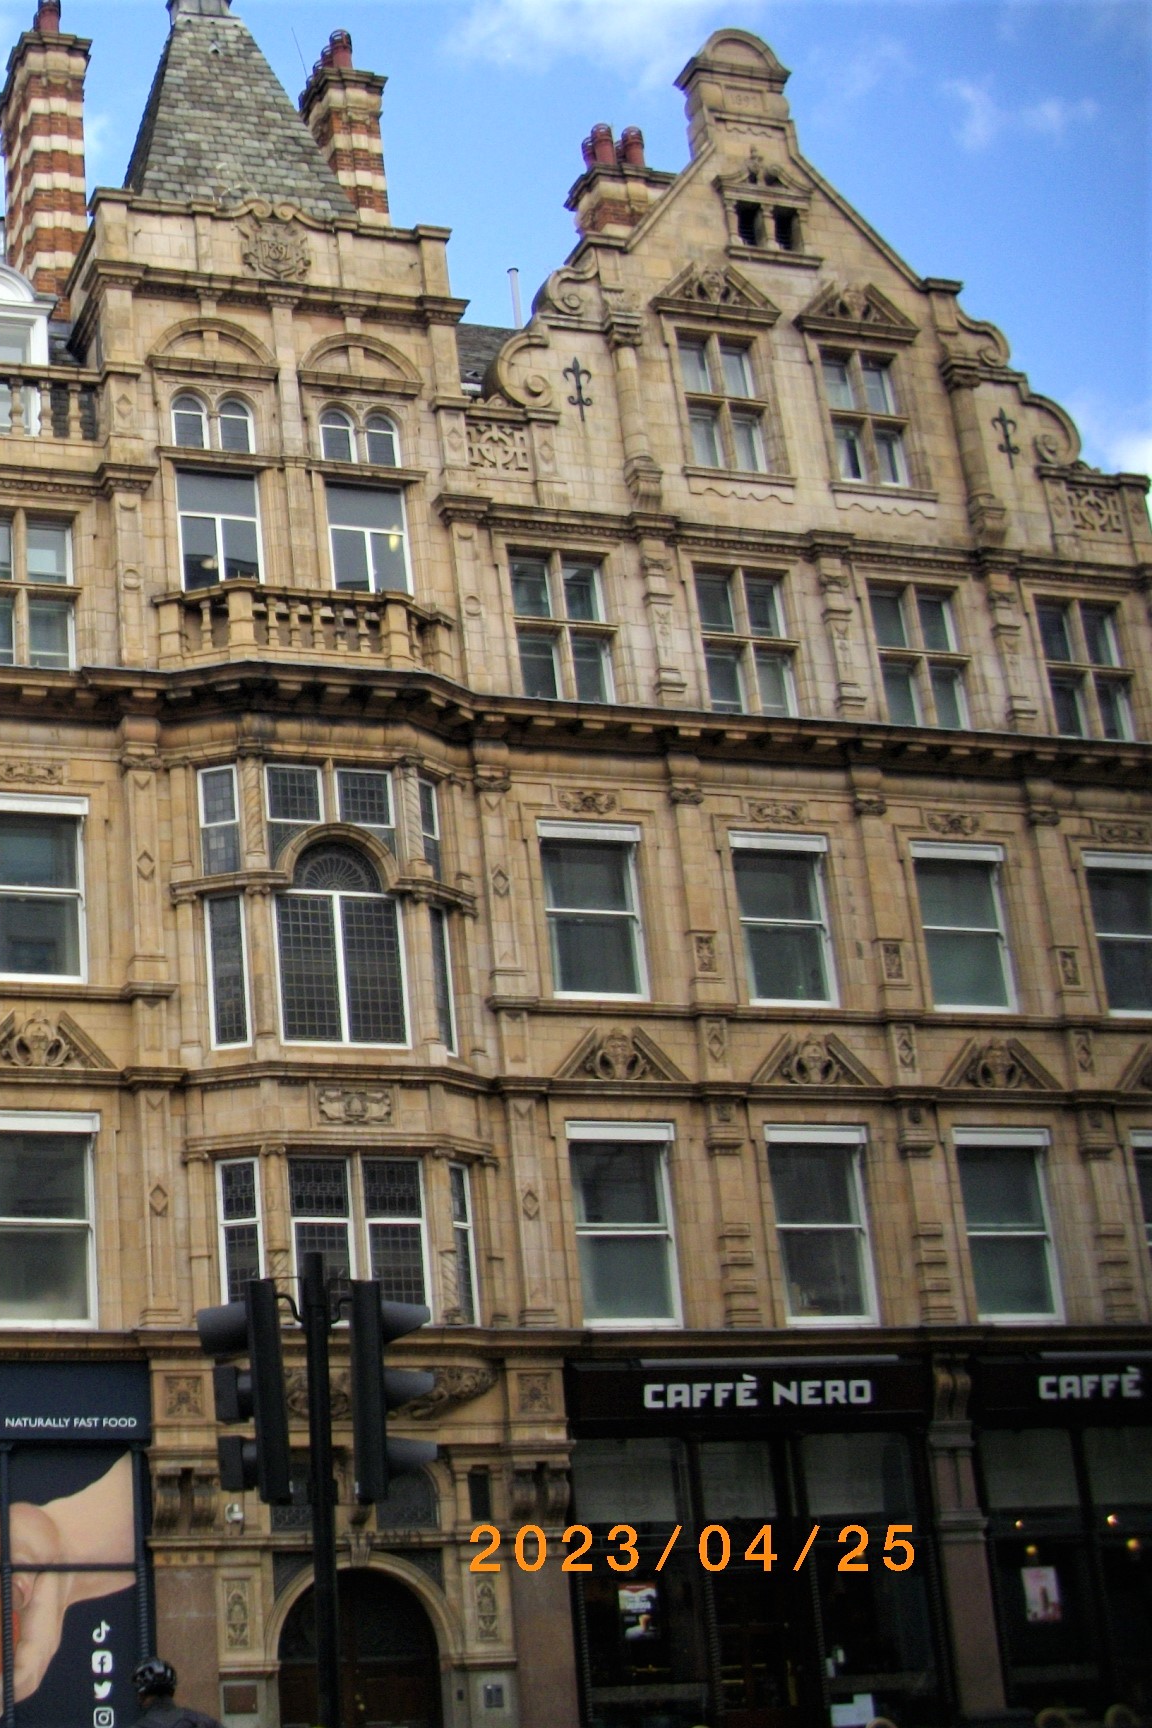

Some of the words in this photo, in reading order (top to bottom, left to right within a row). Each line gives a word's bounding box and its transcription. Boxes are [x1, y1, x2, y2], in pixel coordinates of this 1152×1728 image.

[644, 1373, 758, 1409] CAFFÈ
[772, 1379, 872, 1406] NERO
[1038, 1366, 1142, 1400] CAFFÈ
[4, 1417, 70, 1428] NATURALLY
[73, 1417, 99, 1428] FAST
[102, 1417, 138, 1428] FOOD
